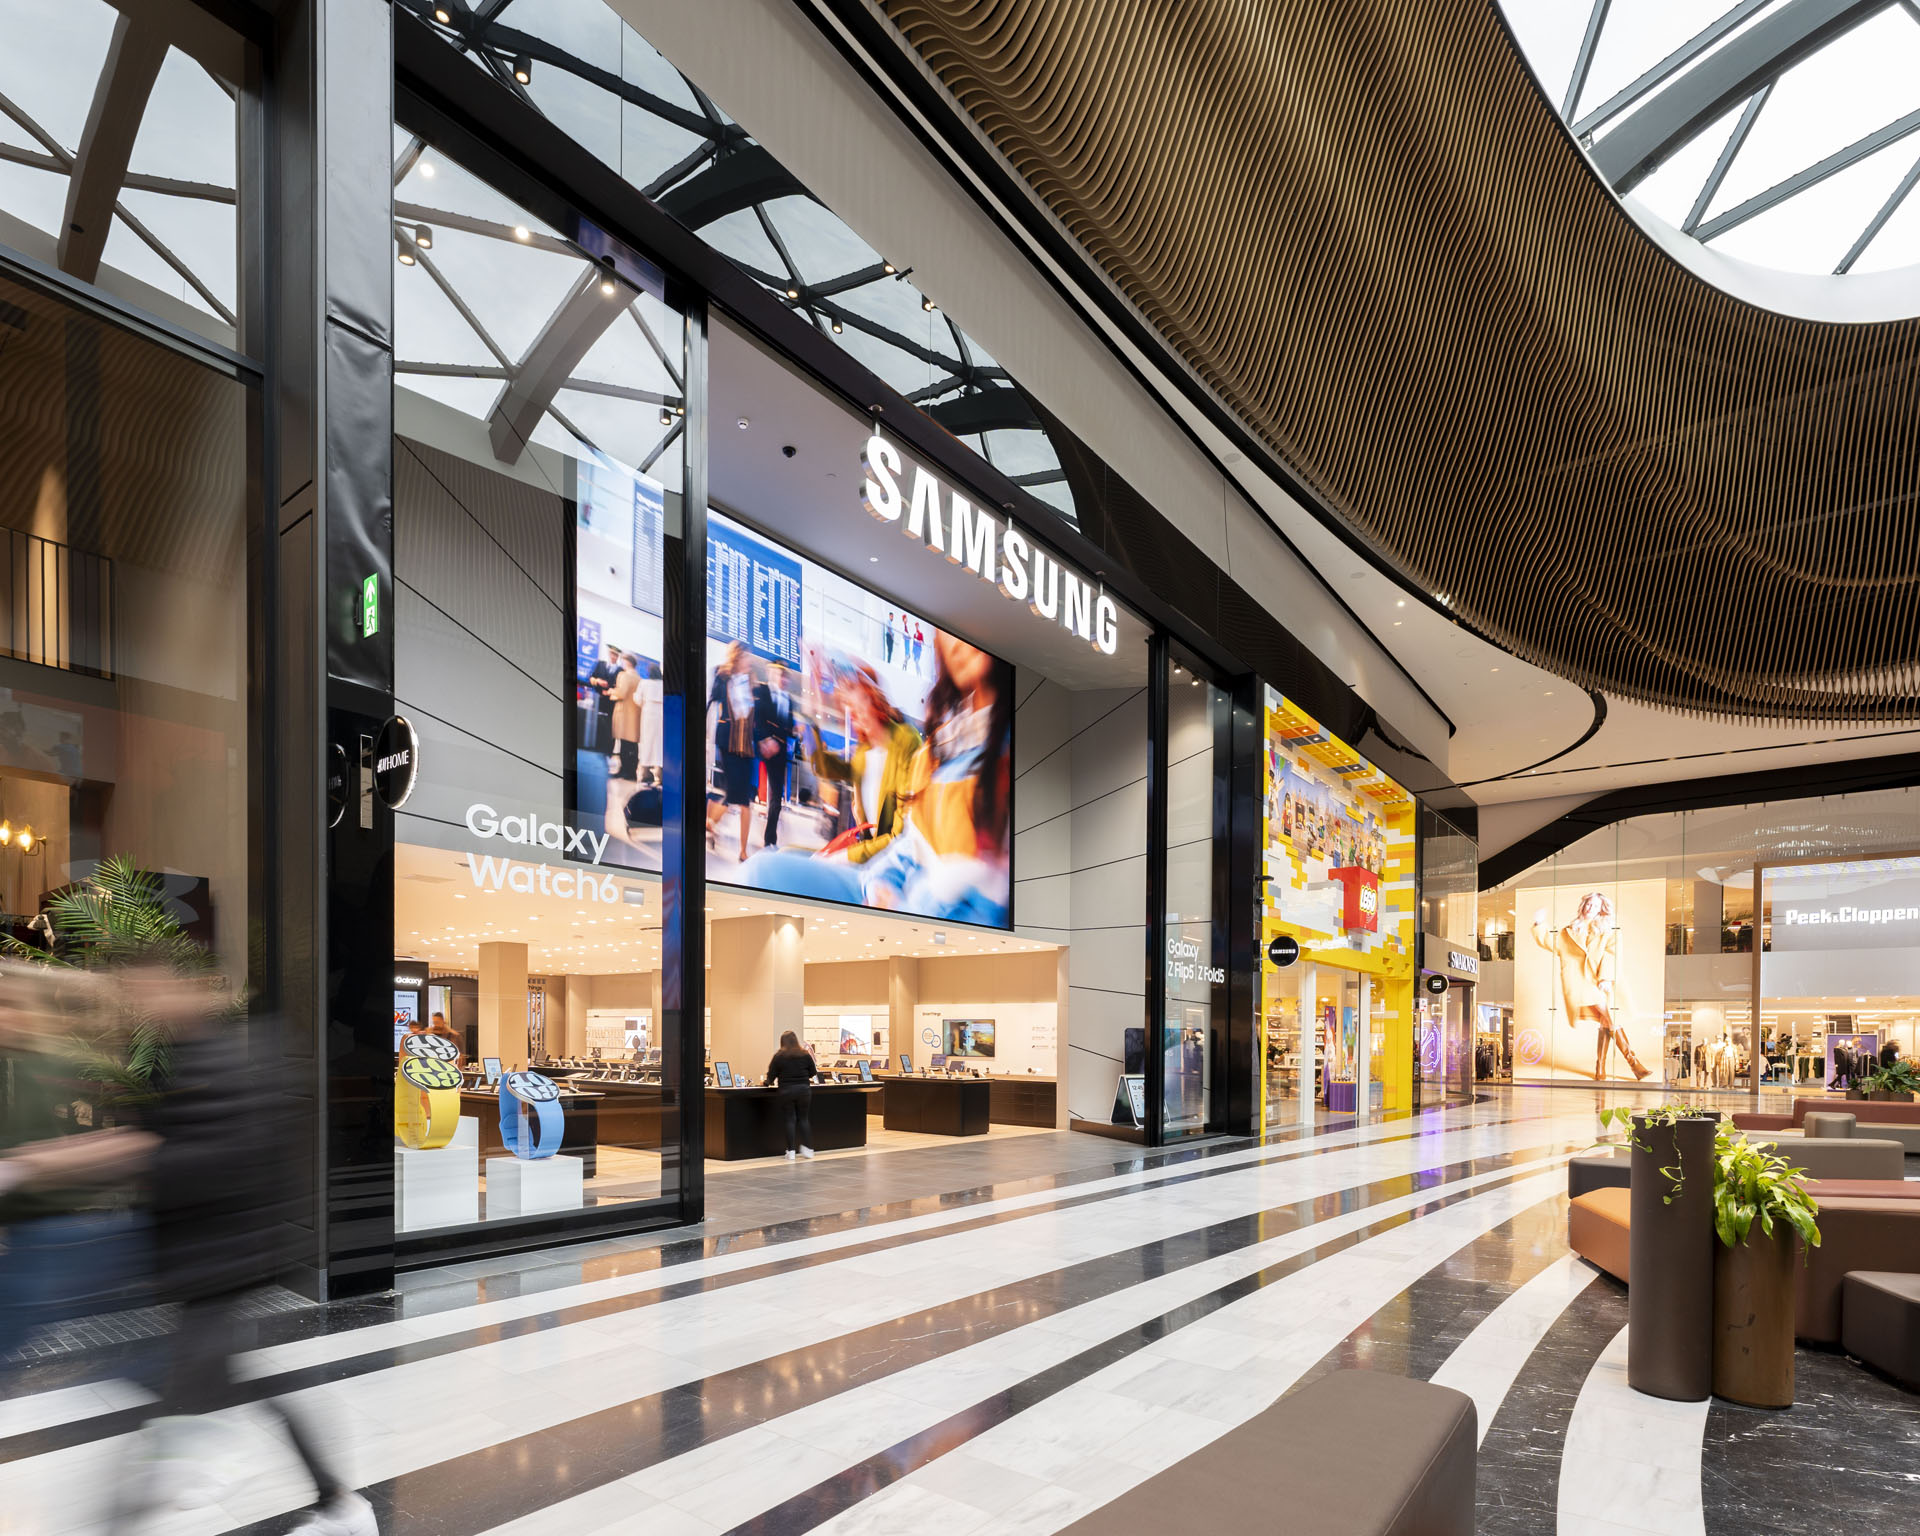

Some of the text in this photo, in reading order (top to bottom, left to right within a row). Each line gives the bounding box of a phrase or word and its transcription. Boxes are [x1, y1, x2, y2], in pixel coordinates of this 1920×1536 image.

[864, 435, 1117, 655] SAMSUNG
[466, 803, 610, 865] Galaxy
[466, 852, 619, 904] Watch6
[1361, 885, 1376, 914] LEGO
[1167, 938, 1199, 962] Galaxy
[396, 976, 422, 986] Galaxy
[1167, 961, 1225, 984] Z Flip5 Z Fold5
